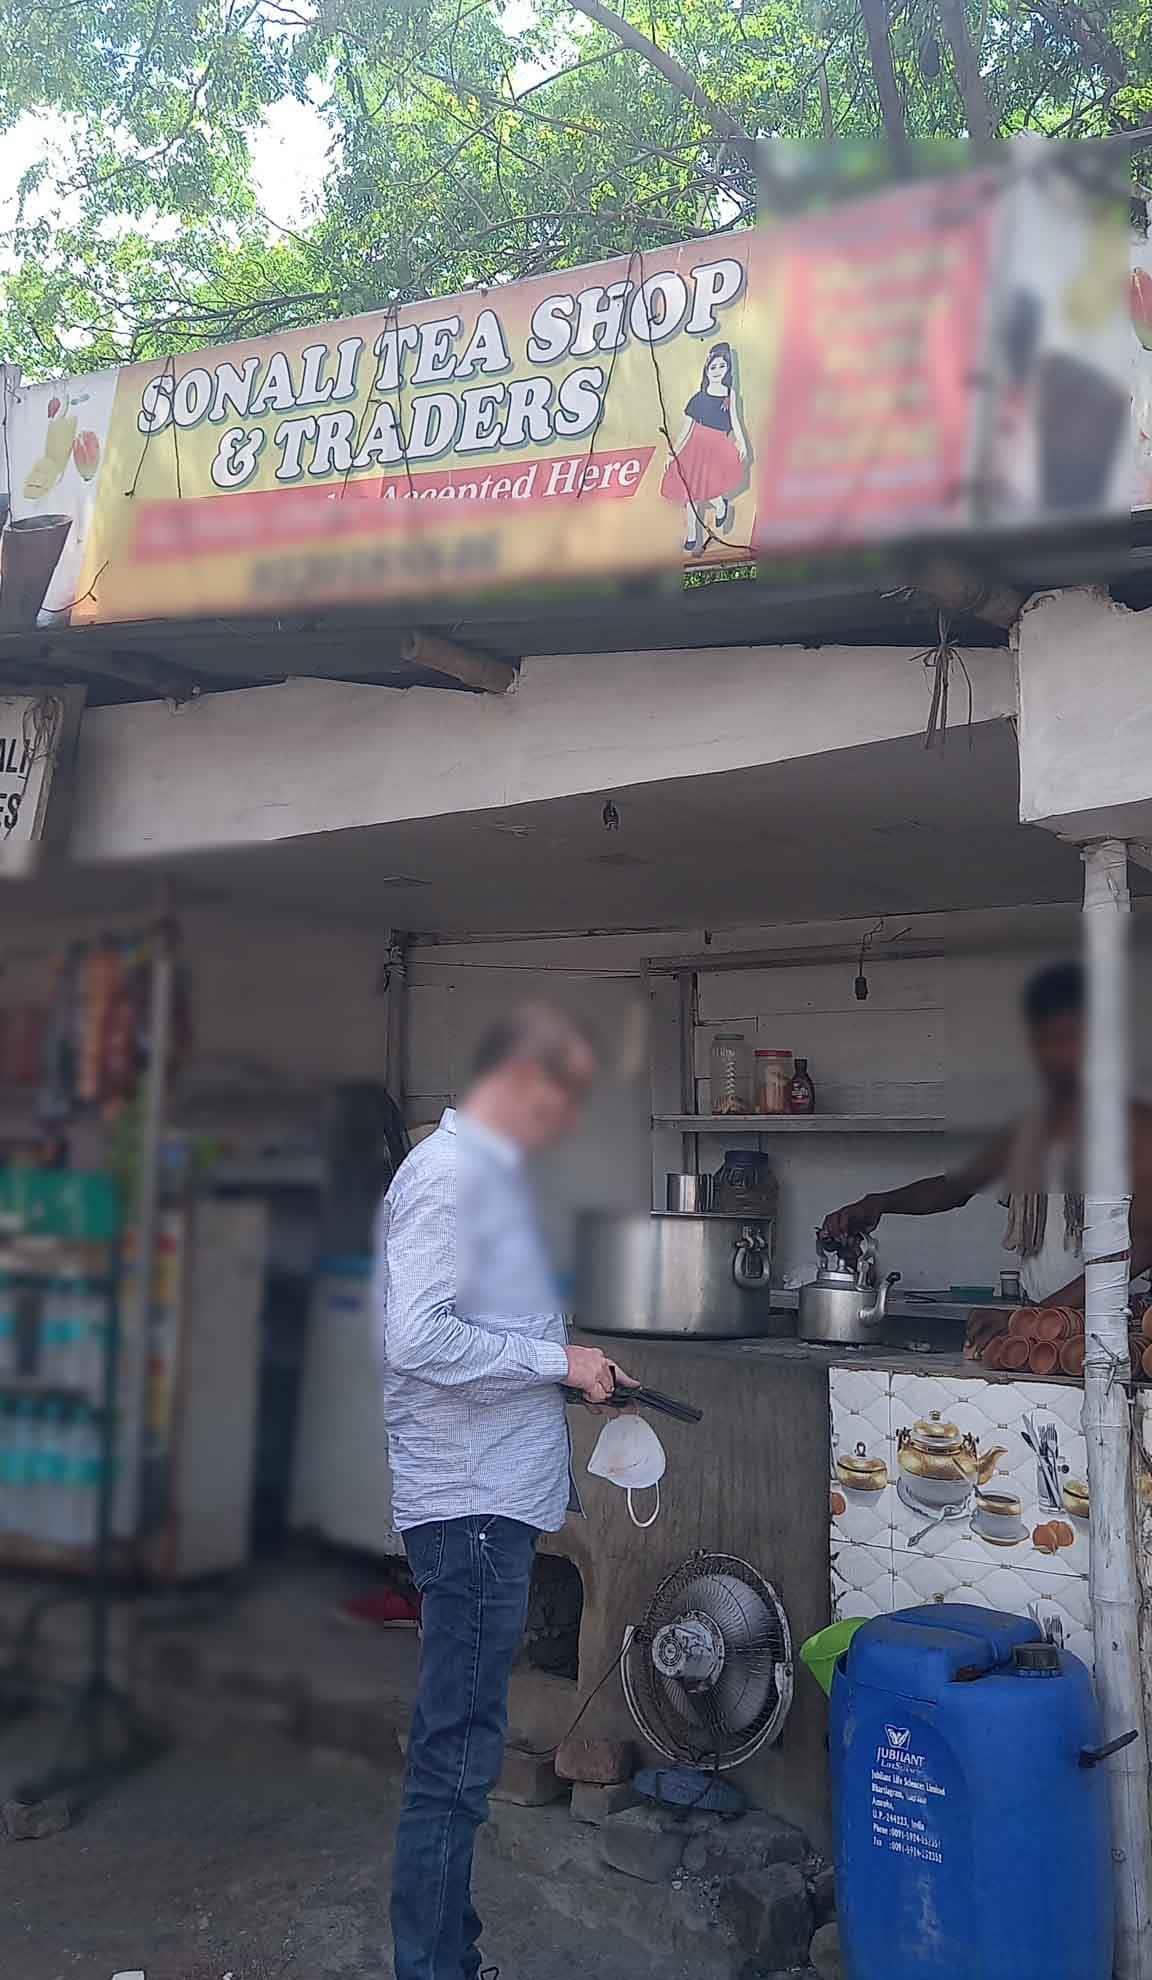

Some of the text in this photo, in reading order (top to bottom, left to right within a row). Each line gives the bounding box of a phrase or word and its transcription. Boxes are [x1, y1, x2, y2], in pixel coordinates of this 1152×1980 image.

[137, 258, 743, 434] SONALI TEA SHOP
[210, 366, 605, 488] & TRADERS
[543, 457, 641, 497] Here
[876, 1746, 926, 1767] JUBILANT
